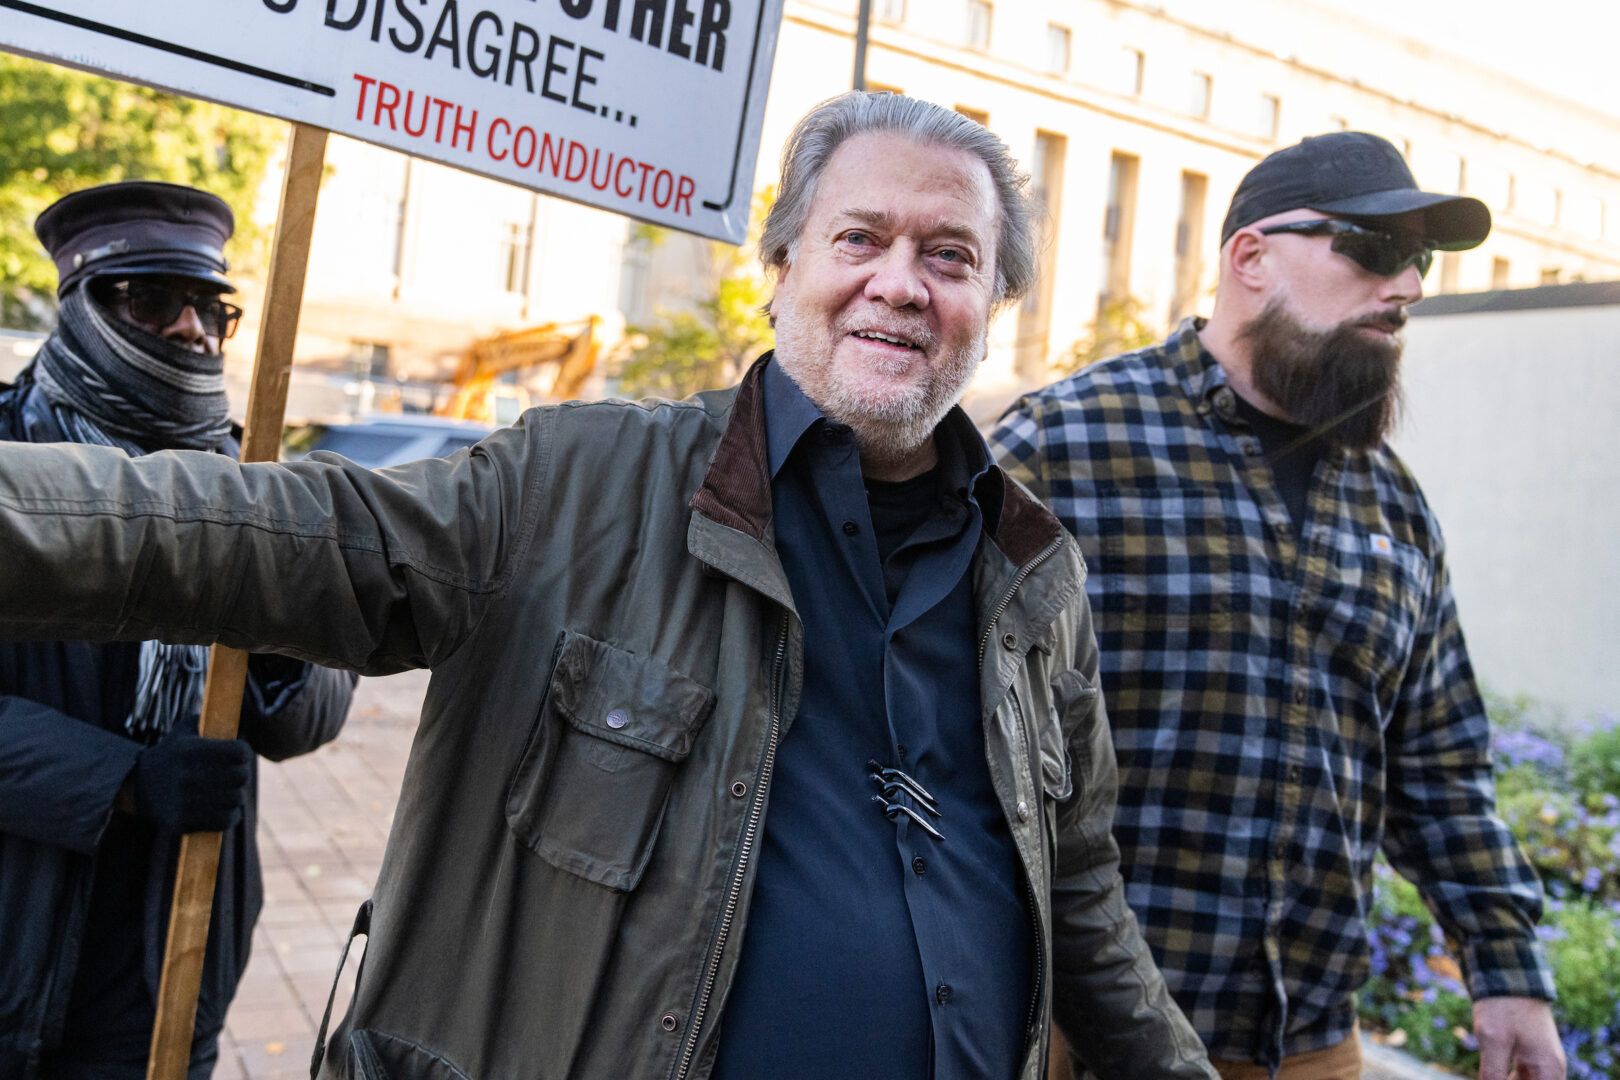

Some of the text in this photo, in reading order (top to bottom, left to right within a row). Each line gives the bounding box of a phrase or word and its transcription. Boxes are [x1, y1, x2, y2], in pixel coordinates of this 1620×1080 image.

[558, 0, 733, 73] HER
[353, 73, 696, 217] TRUTH CONDUCTOR
